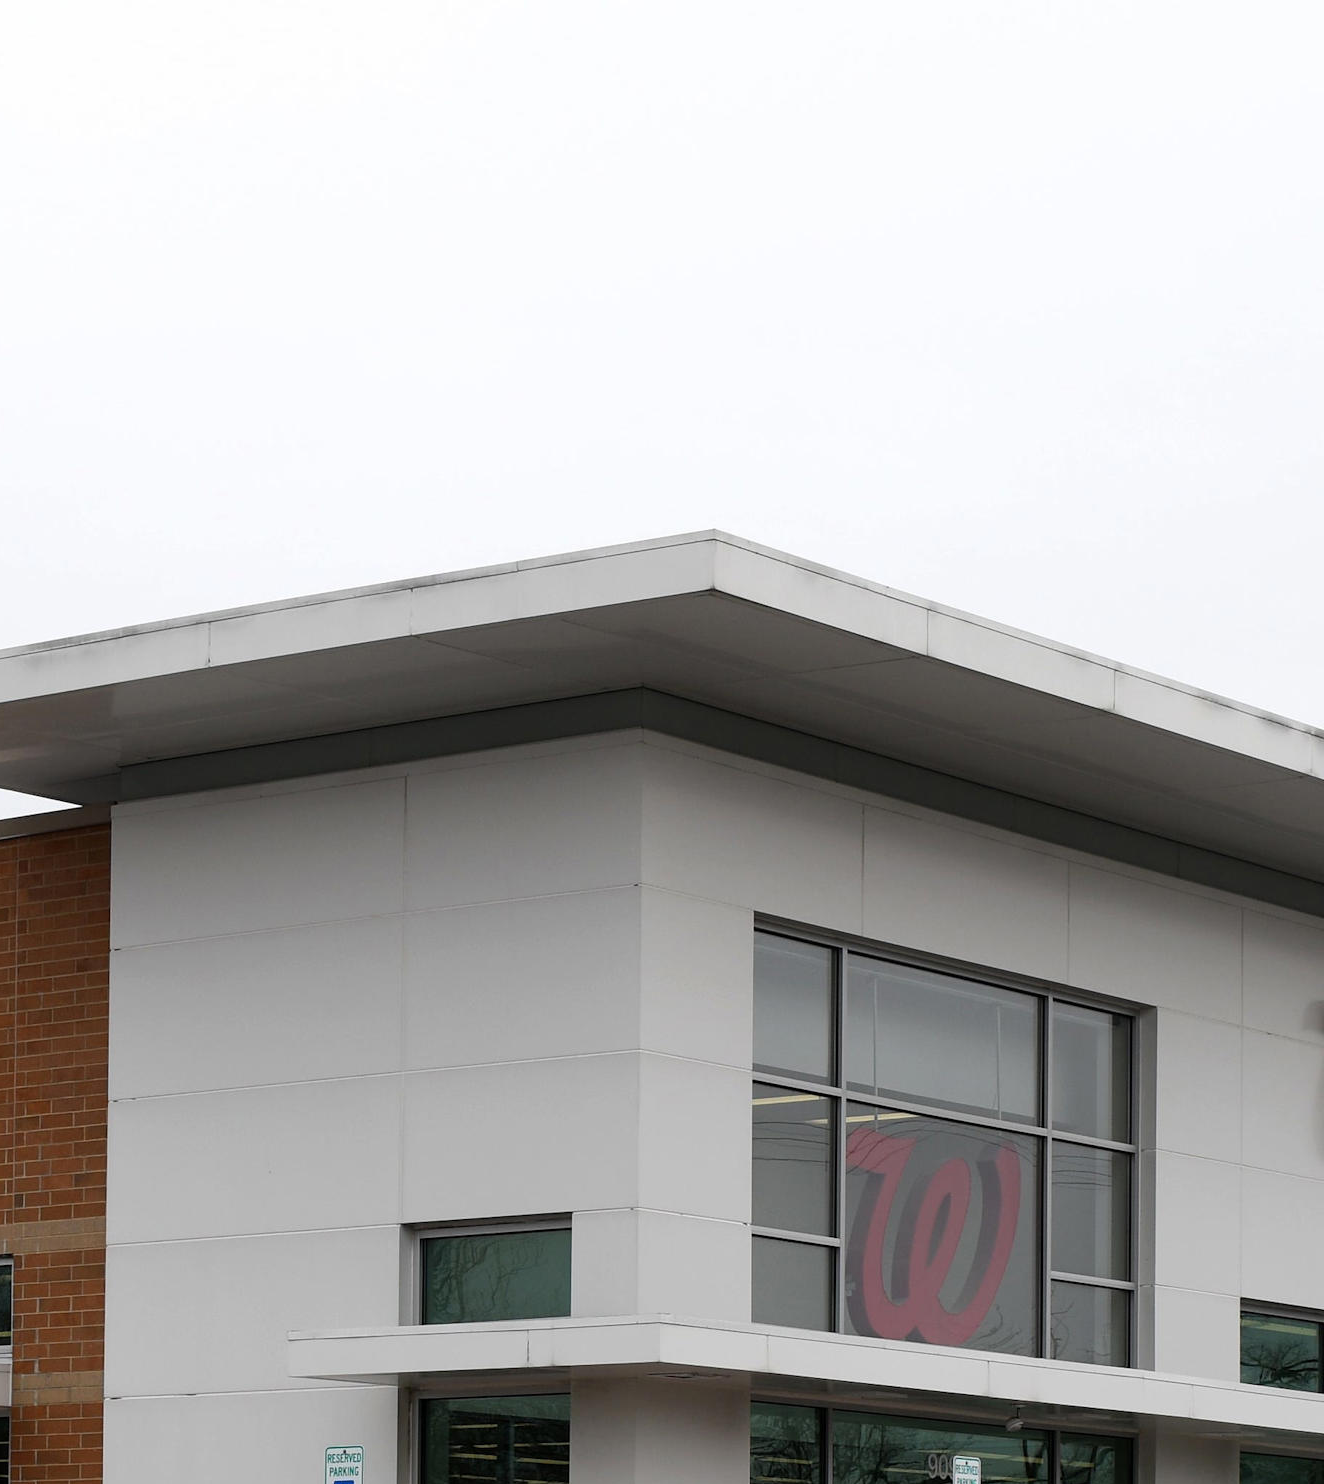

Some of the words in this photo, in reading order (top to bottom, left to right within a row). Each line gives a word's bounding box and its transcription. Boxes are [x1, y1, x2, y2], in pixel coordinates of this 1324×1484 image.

[327, 1453, 362, 1464] RESERVED
[329, 1466, 359, 1477] PARKING
[956, 1464, 978, 1476] RESERVED
